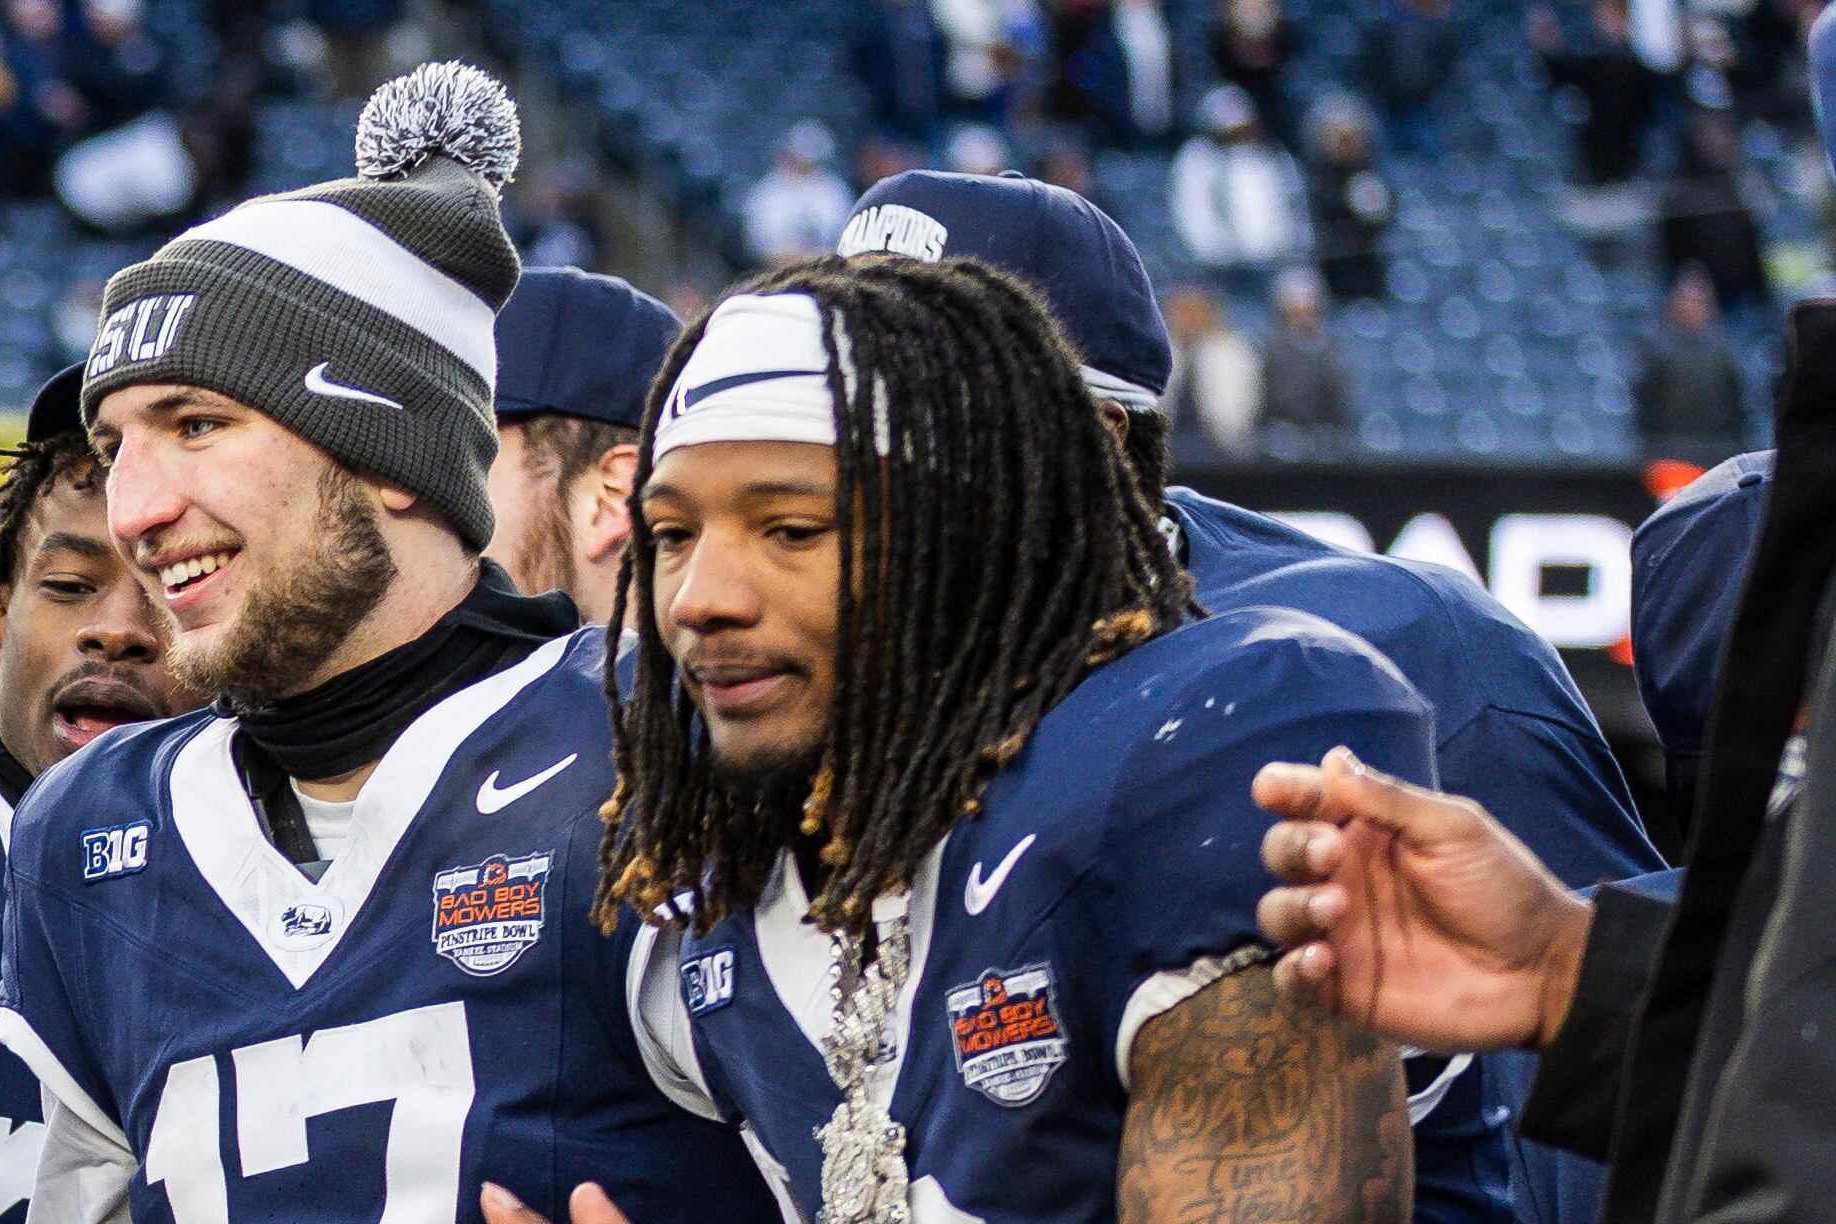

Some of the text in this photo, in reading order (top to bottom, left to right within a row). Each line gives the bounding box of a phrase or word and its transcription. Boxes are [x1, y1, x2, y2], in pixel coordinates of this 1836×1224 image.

[88, 293, 195, 379] SU
[1261, 511, 1634, 648] AD
[440, 881, 540, 910] BAD BOY
[438, 896, 540, 927] MOWERS
[440, 924, 536, 949] PINSTRIPE BOWL
